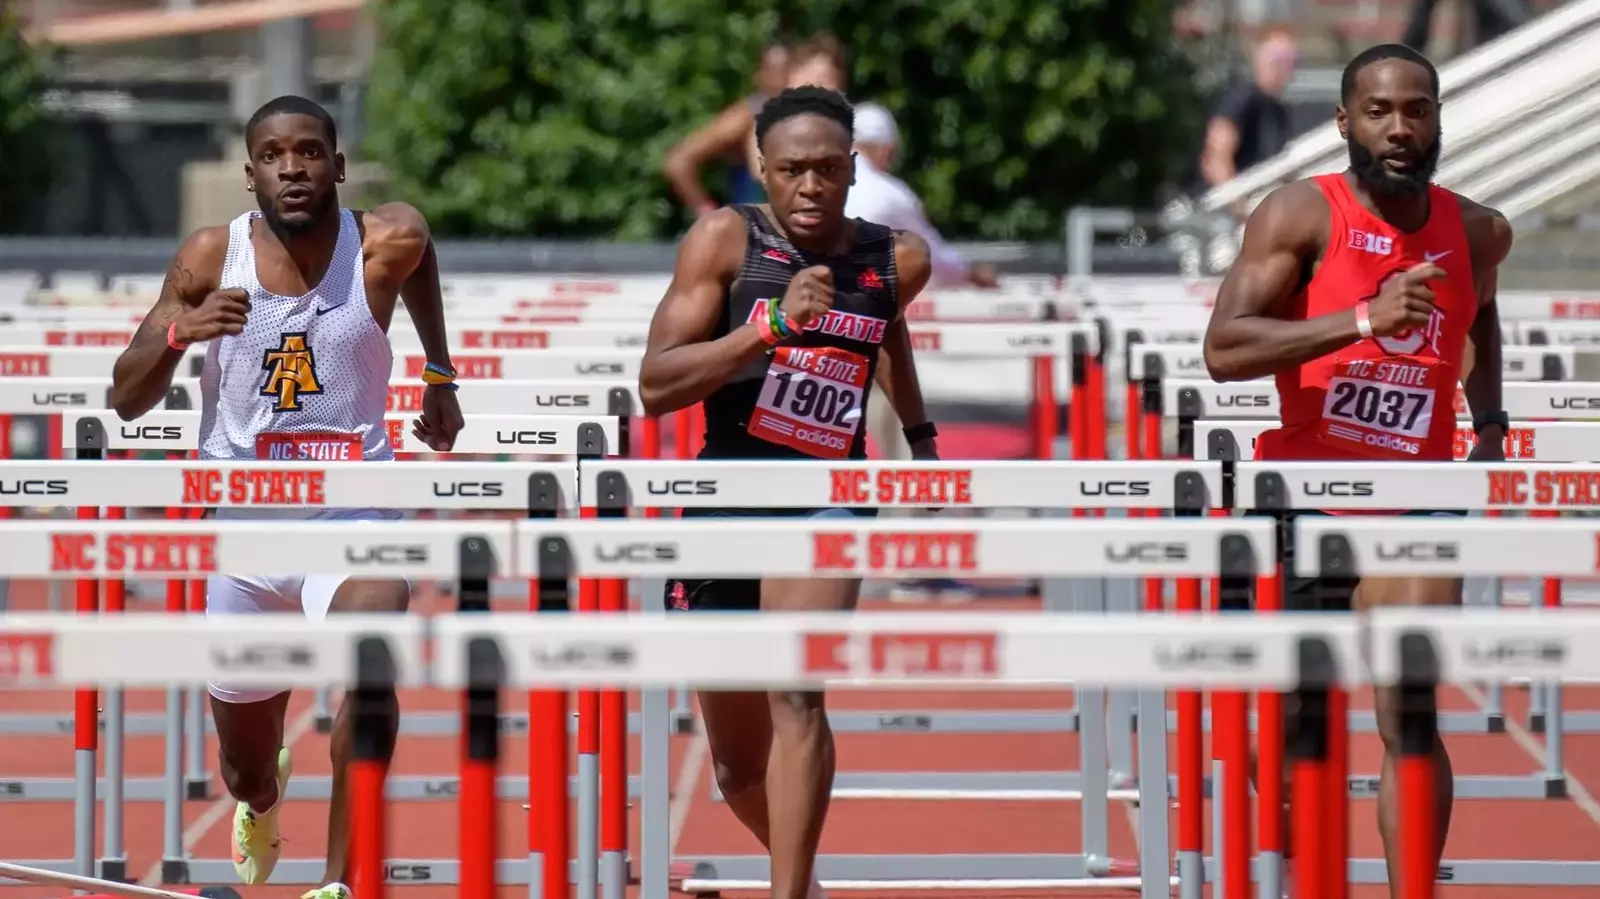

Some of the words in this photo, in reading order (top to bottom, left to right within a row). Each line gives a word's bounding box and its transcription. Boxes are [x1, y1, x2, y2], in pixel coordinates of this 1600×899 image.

[786, 348, 814, 369] NC
[814, 355, 860, 383] STATE
[1345, 360, 1375, 377] NC
[1375, 363, 1429, 386] STATE
[33, 392, 87, 405] UCS
[536, 395, 590, 407] UCS
[772, 372, 856, 429] 1902
[1216, 395, 1271, 407] UCS
[1330, 381, 1429, 431] 2037
[120, 425, 182, 440] UCS
[496, 430, 558, 444] UCS
[796, 428, 846, 449] adidas
[269, 442, 293, 460] NC
[298, 441, 350, 460] STATE
[1364, 434, 1420, 455] adidas
[0, 480, 69, 494] UCS
[182, 469, 223, 504] NC
[228, 469, 326, 504] STATE
[433, 481, 504, 497] UCS
[647, 480, 718, 495] UCS
[830, 469, 869, 504] NC
[876, 469, 972, 504] STATE
[1080, 481, 1151, 496] UCS
[1303, 481, 1375, 497] UCS
[1486, 470, 1529, 505] NC
[50, 533, 97, 571] NC
[104, 532, 218, 571] STATE
[345, 544, 429, 564] UCS
[595, 542, 680, 563] UCS
[812, 531, 858, 571] NC
[866, 531, 978, 570] STATE
[1104, 542, 1189, 562] UCS
[1375, 543, 1460, 561] UCS
[384, 866, 431, 879] CS
